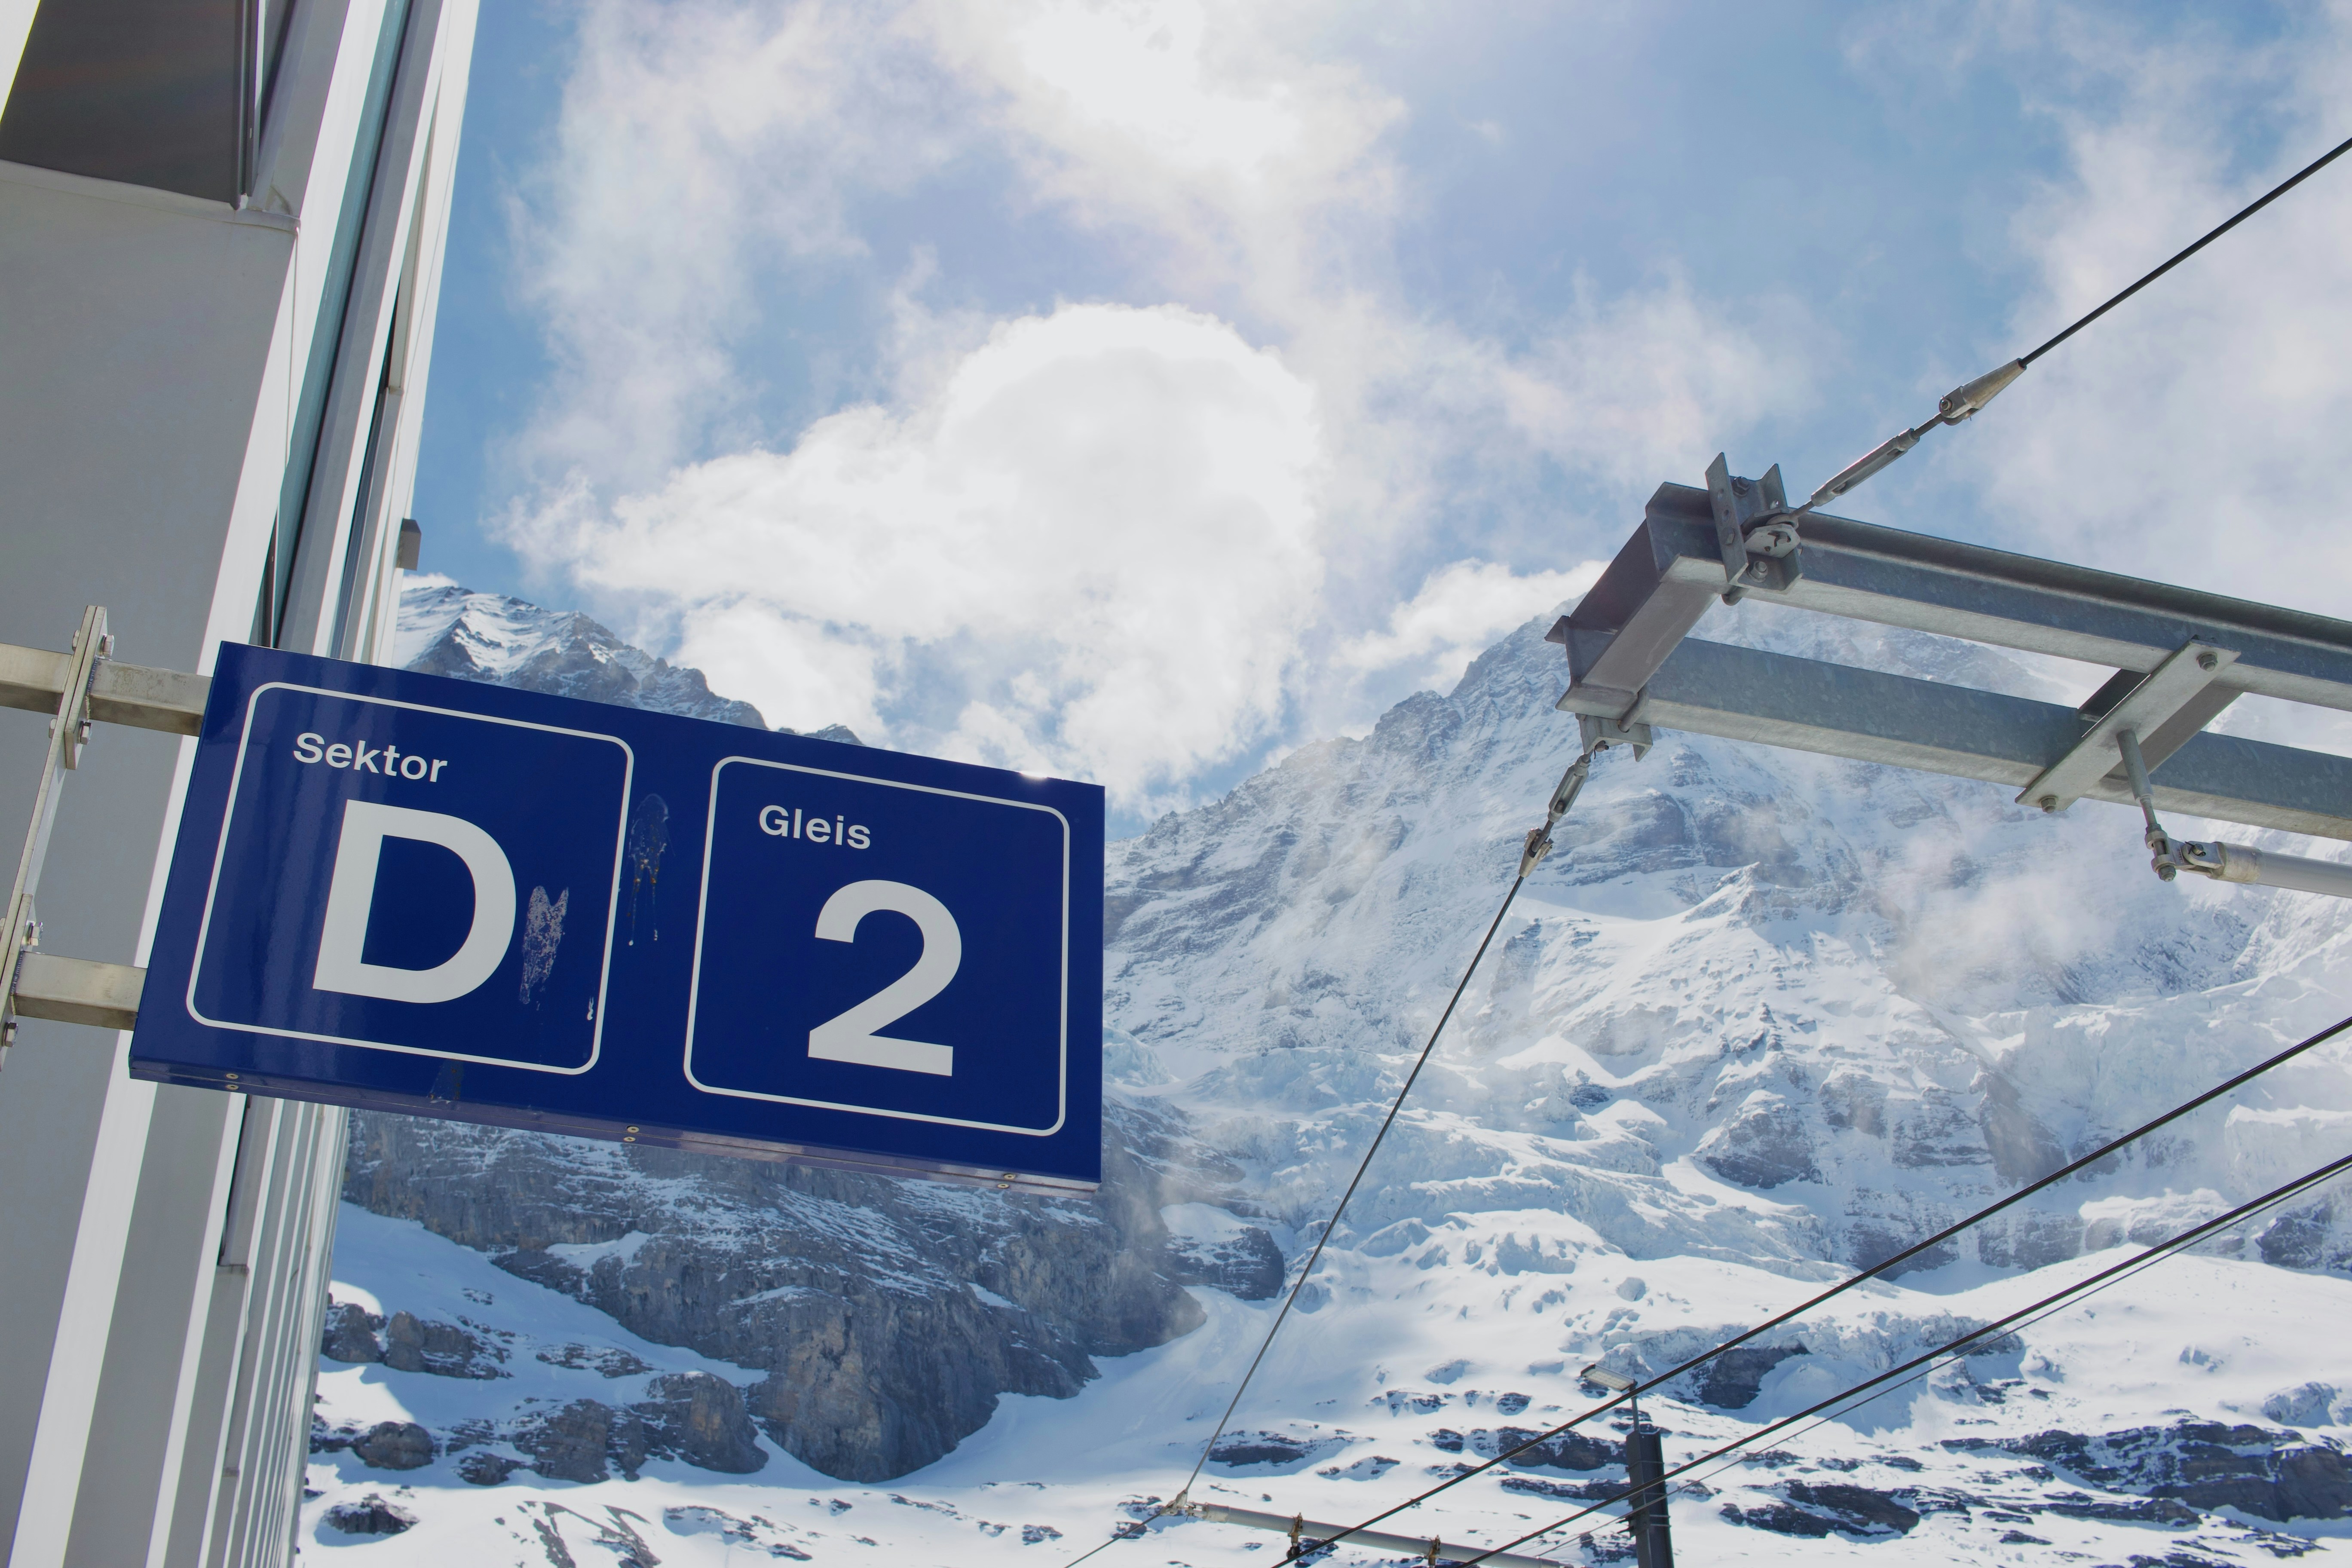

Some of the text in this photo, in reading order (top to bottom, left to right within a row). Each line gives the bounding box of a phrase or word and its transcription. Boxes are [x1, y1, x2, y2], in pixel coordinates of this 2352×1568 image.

[293, 732, 448, 783] Sektor
[760, 805, 871, 849] Gleis
[312, 799, 516, 1003] D
[808, 879, 962, 1076] 2
